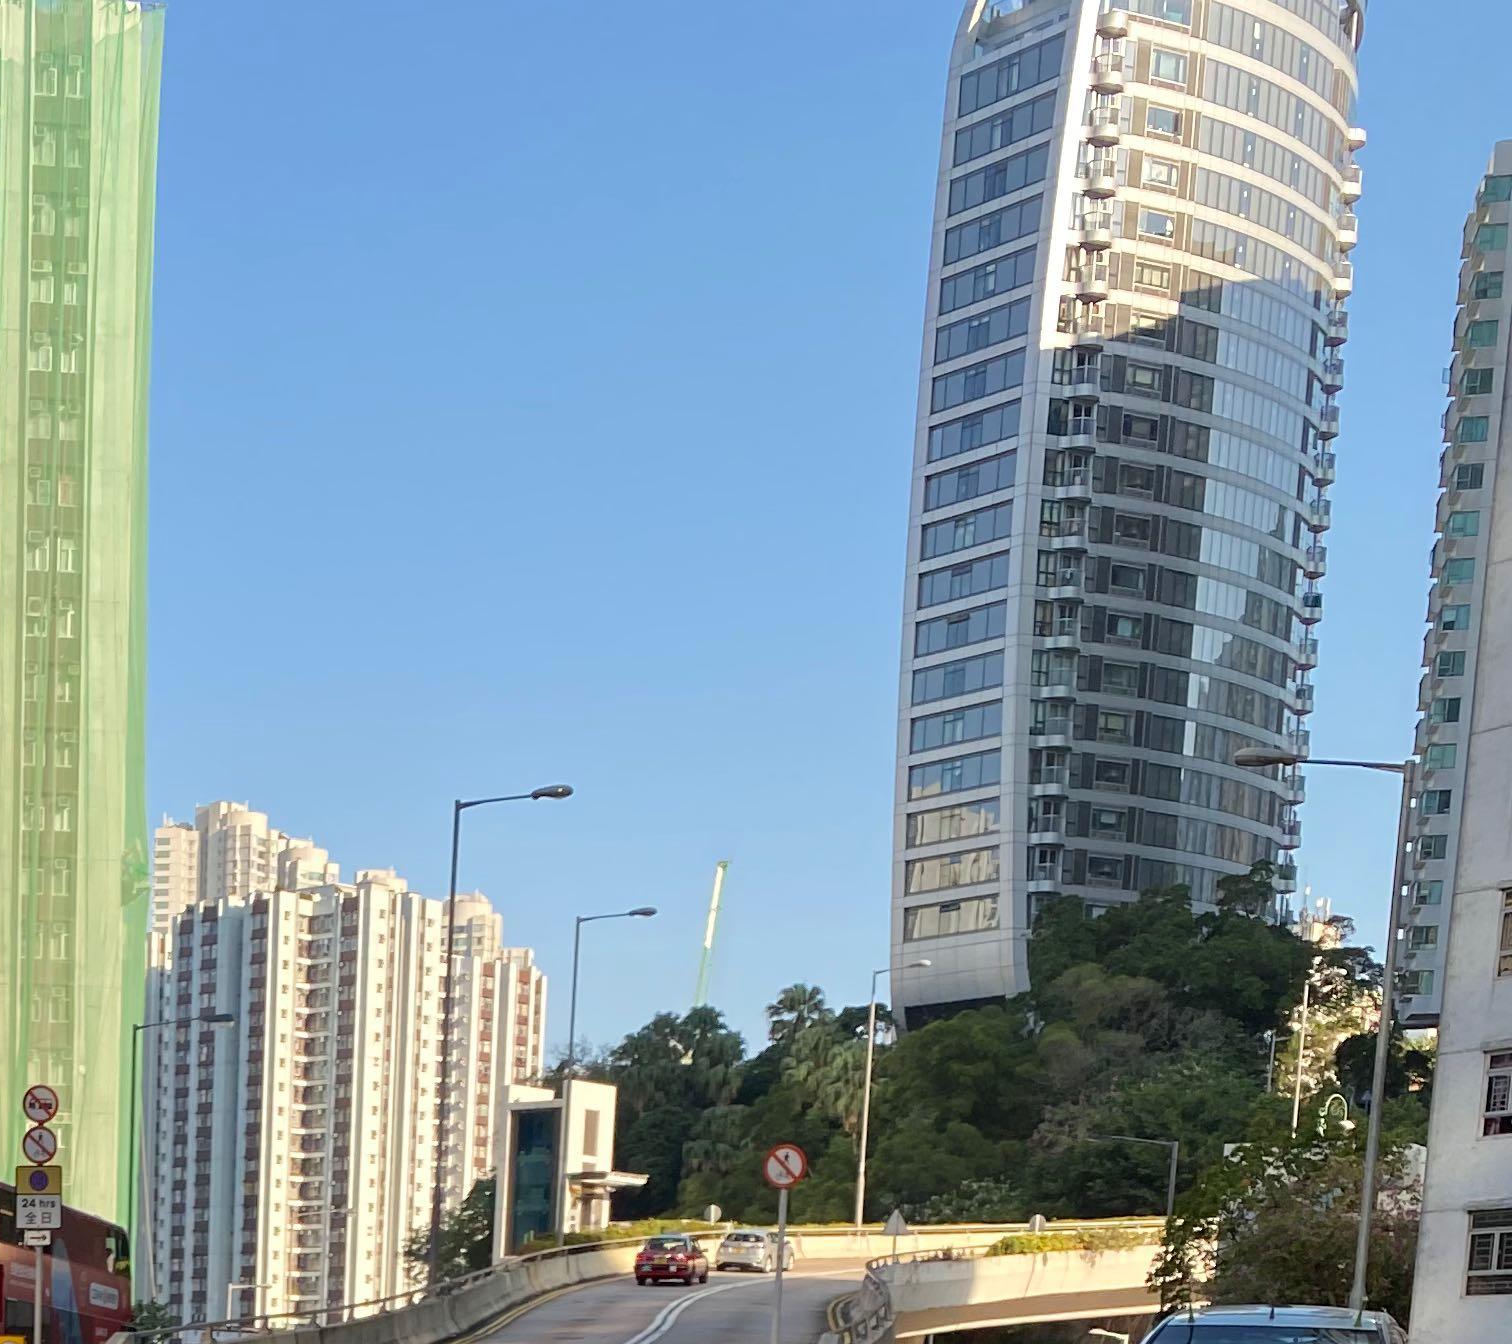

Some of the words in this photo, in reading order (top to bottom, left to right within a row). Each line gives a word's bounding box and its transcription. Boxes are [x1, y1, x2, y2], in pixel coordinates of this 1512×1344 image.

[21, 1198, 36, 1208] 24
[39, 1199, 56, 1208] hrs
[25, 1211, 52, 1225] 全日
